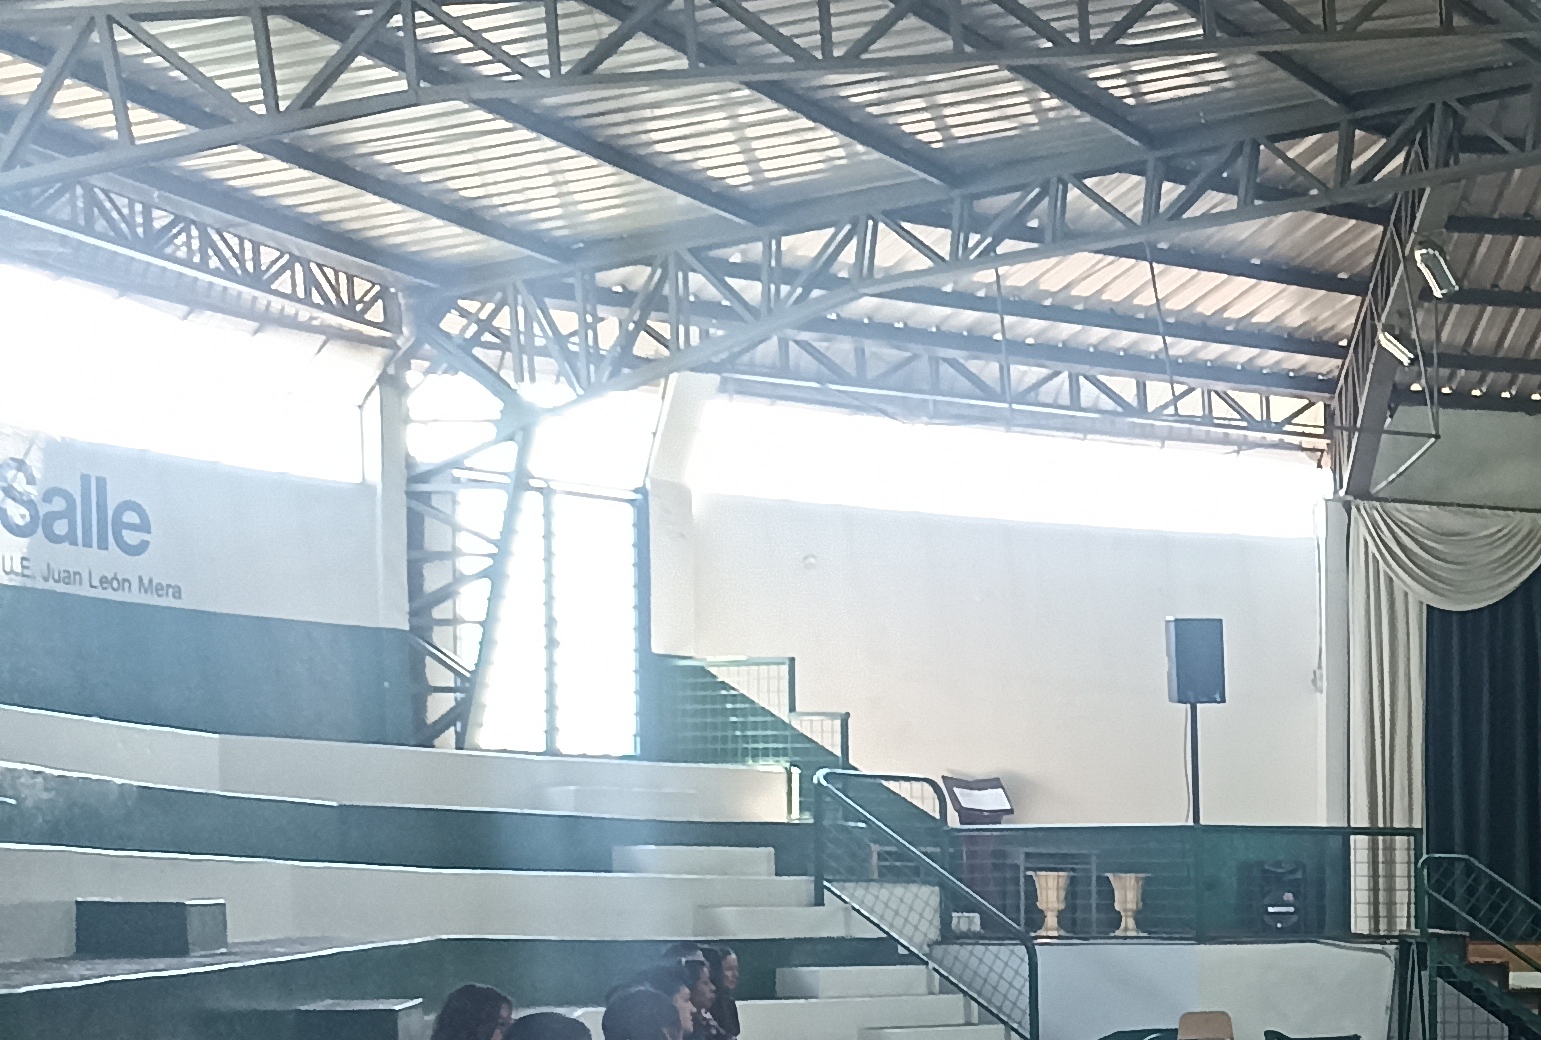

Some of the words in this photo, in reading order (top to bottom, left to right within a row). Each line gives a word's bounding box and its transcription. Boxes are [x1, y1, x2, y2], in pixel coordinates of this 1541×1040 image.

[0, 457, 152, 556] Salle
[42, 563, 82, 586] Juan
[88, 569, 132, 593] León
[138, 575, 182, 600] Mera
